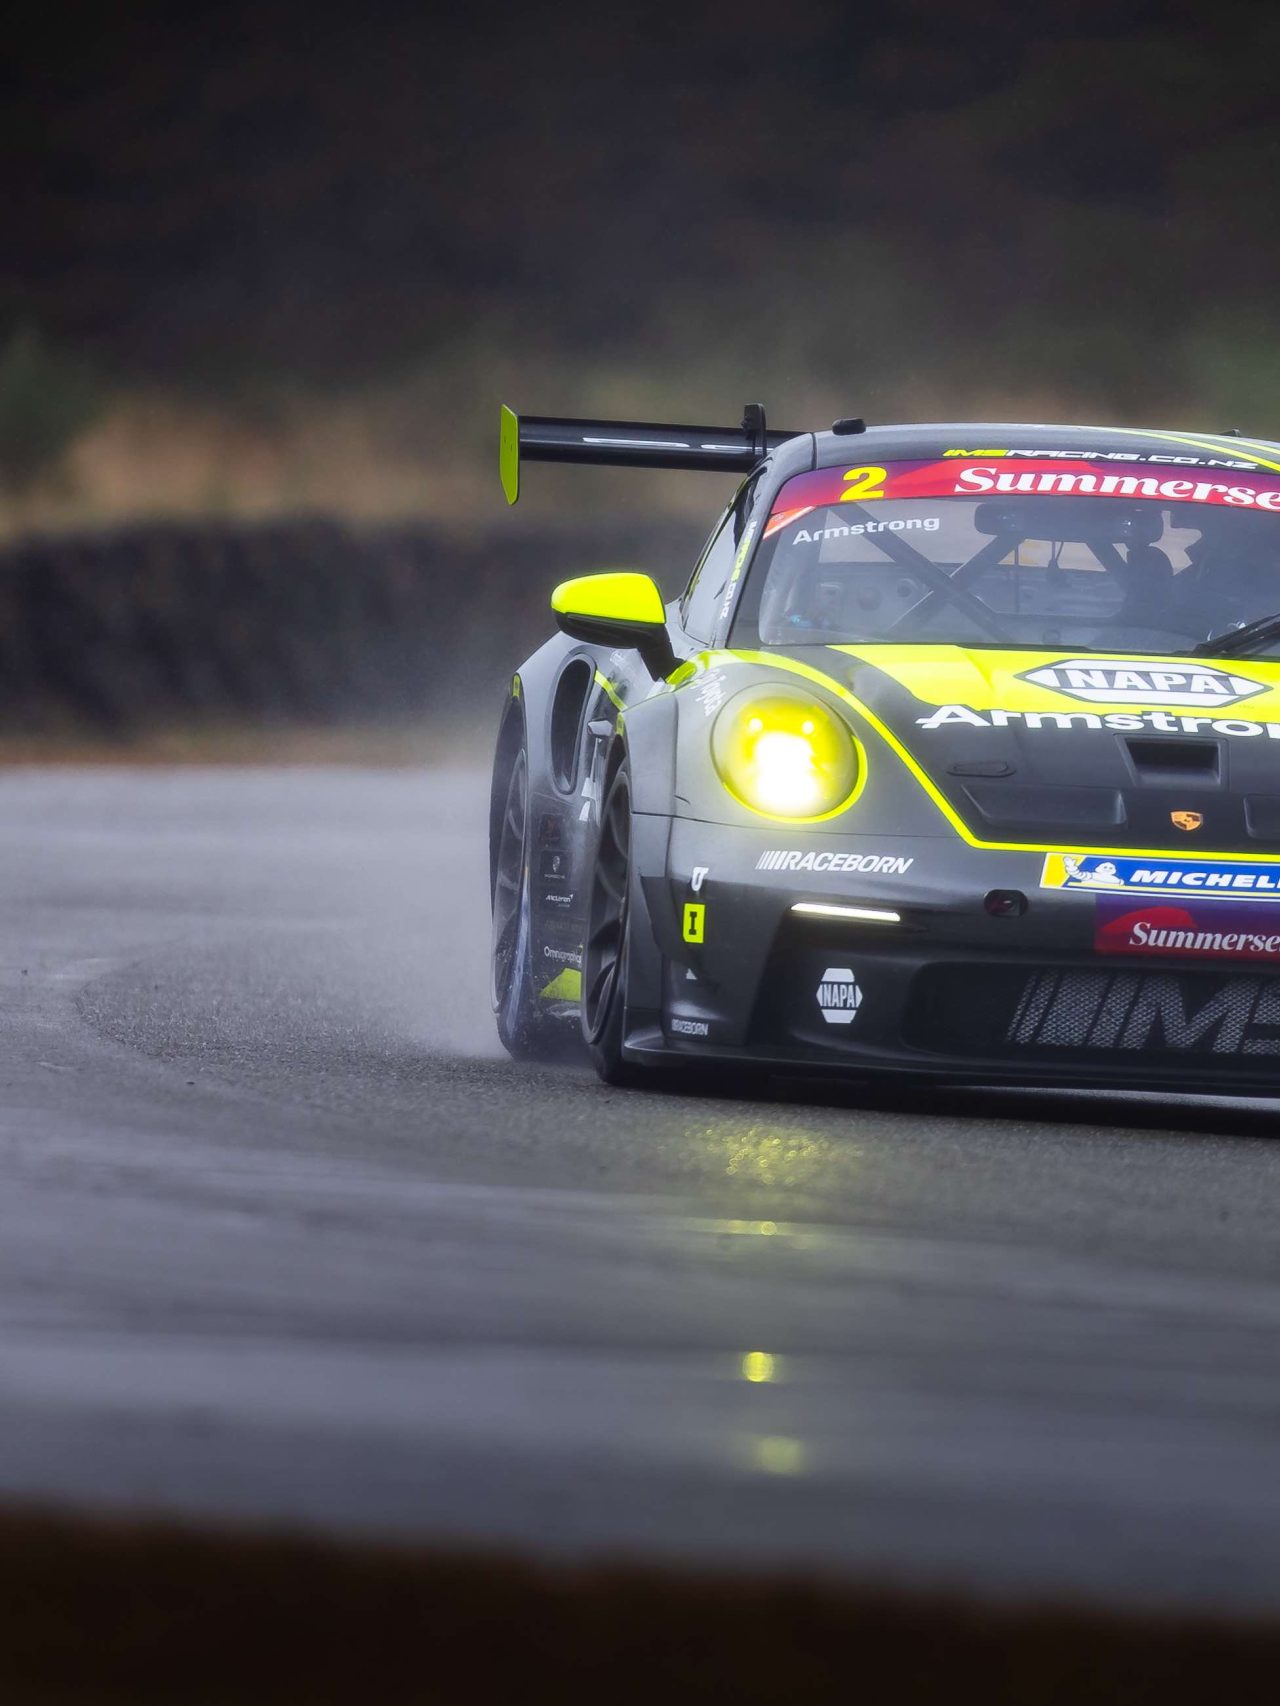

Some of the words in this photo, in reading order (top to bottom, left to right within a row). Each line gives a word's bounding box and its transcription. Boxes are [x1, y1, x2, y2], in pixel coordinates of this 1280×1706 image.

[839, 466, 888, 501] 2
[792, 517, 940, 546] Armstrong
[1064, 669, 1231, 696] NAPA
[778, 850, 914, 874] RACEBORN
[821, 984, 855, 1008] NAPA
